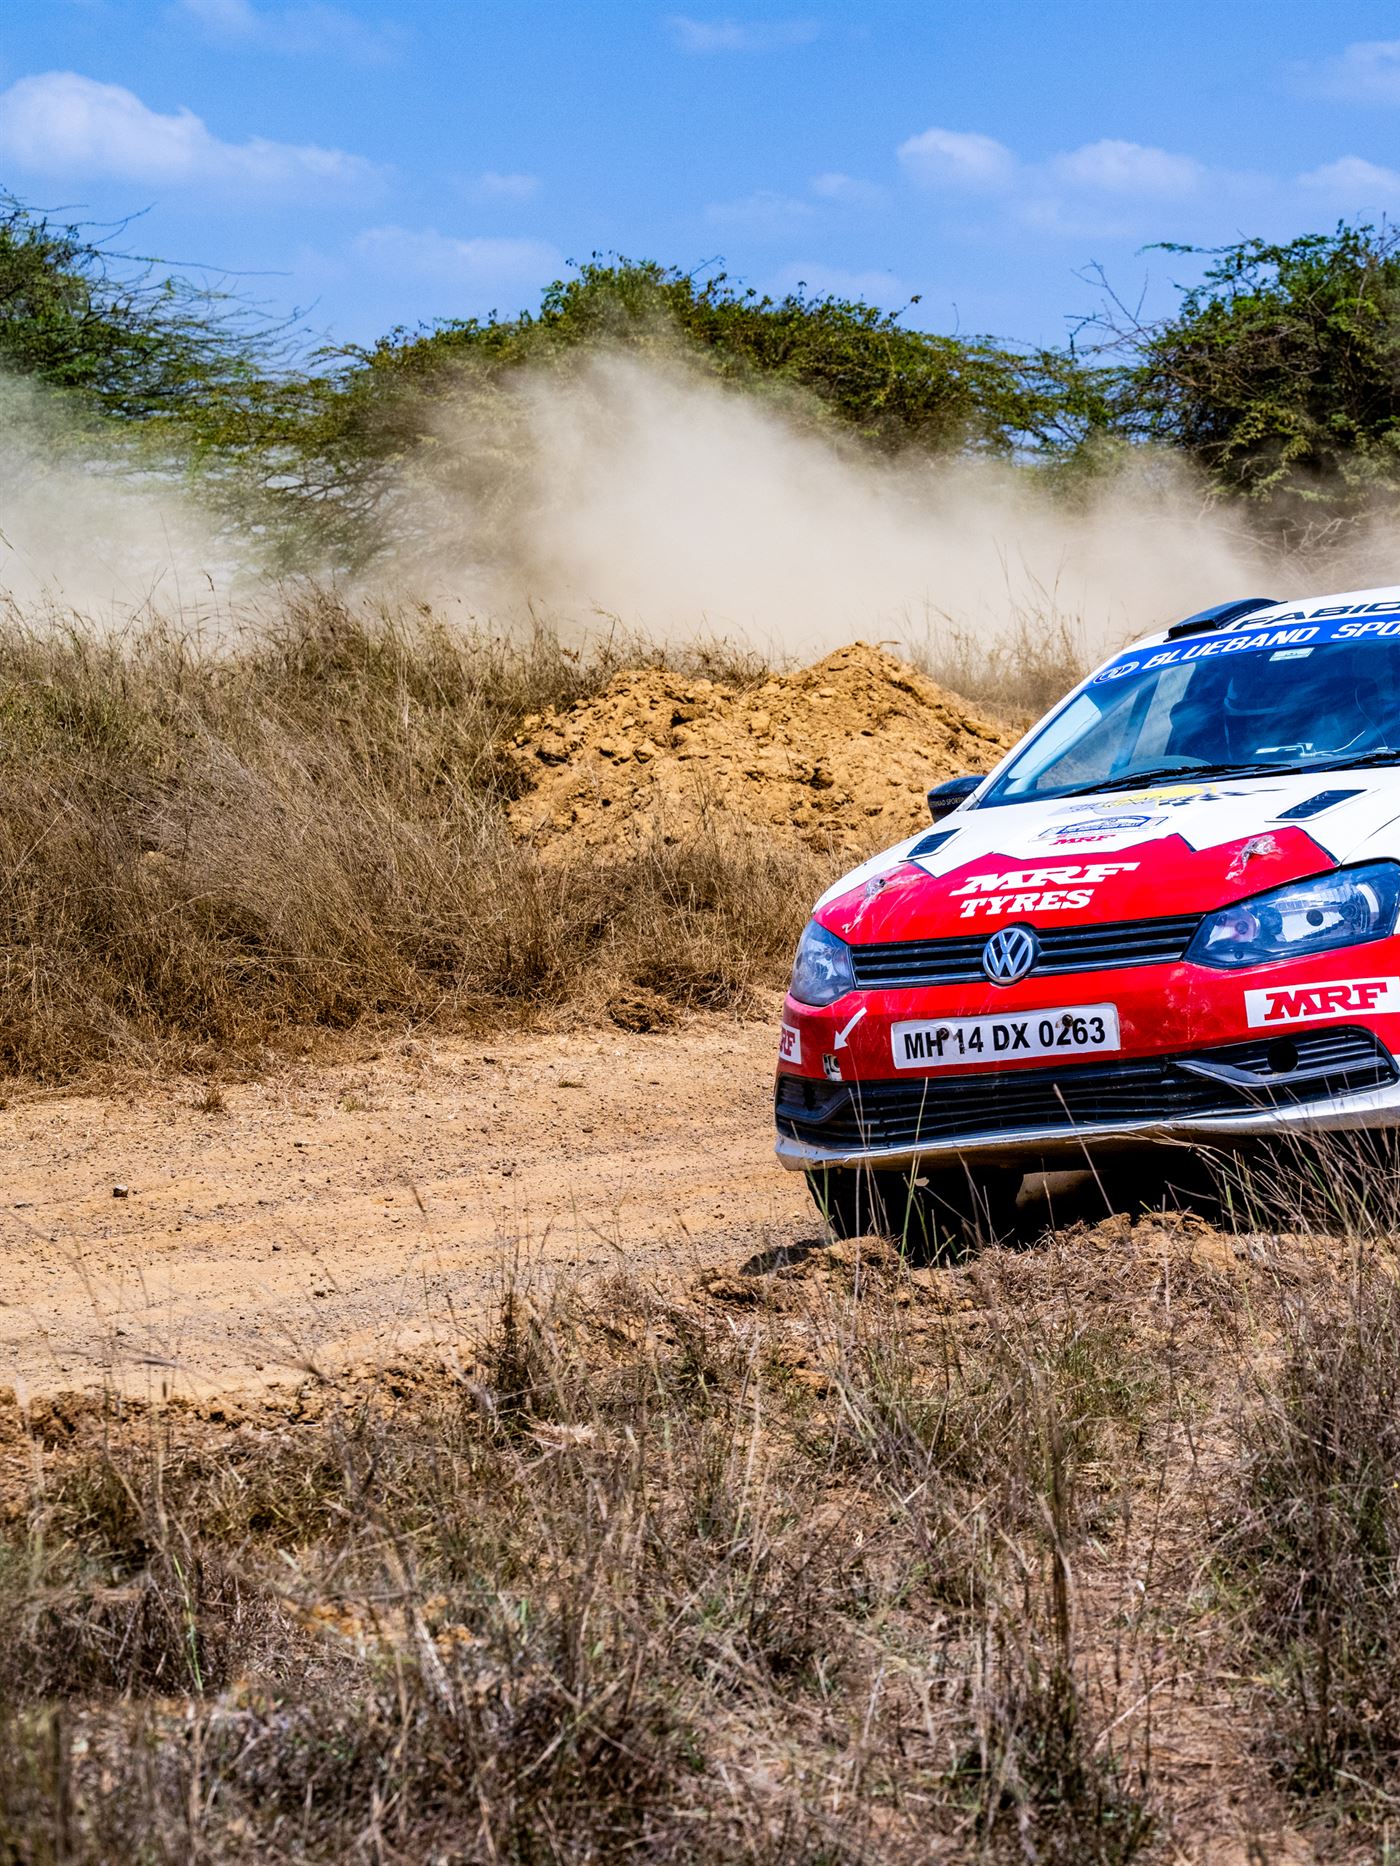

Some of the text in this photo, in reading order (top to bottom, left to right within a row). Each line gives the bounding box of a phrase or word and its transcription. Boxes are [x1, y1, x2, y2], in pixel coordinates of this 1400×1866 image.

[1141, 626, 1320, 670] BLUEBAND
[1048, 834, 1117, 846] MRF
[948, 861, 1141, 896] MRF
[959, 889, 1095, 919] TYRES
[1263, 982, 1388, 1021] MRF
[780, 1026, 796, 1057] RF
[904, 1016, 1106, 1060] MH 14 DX 0263
